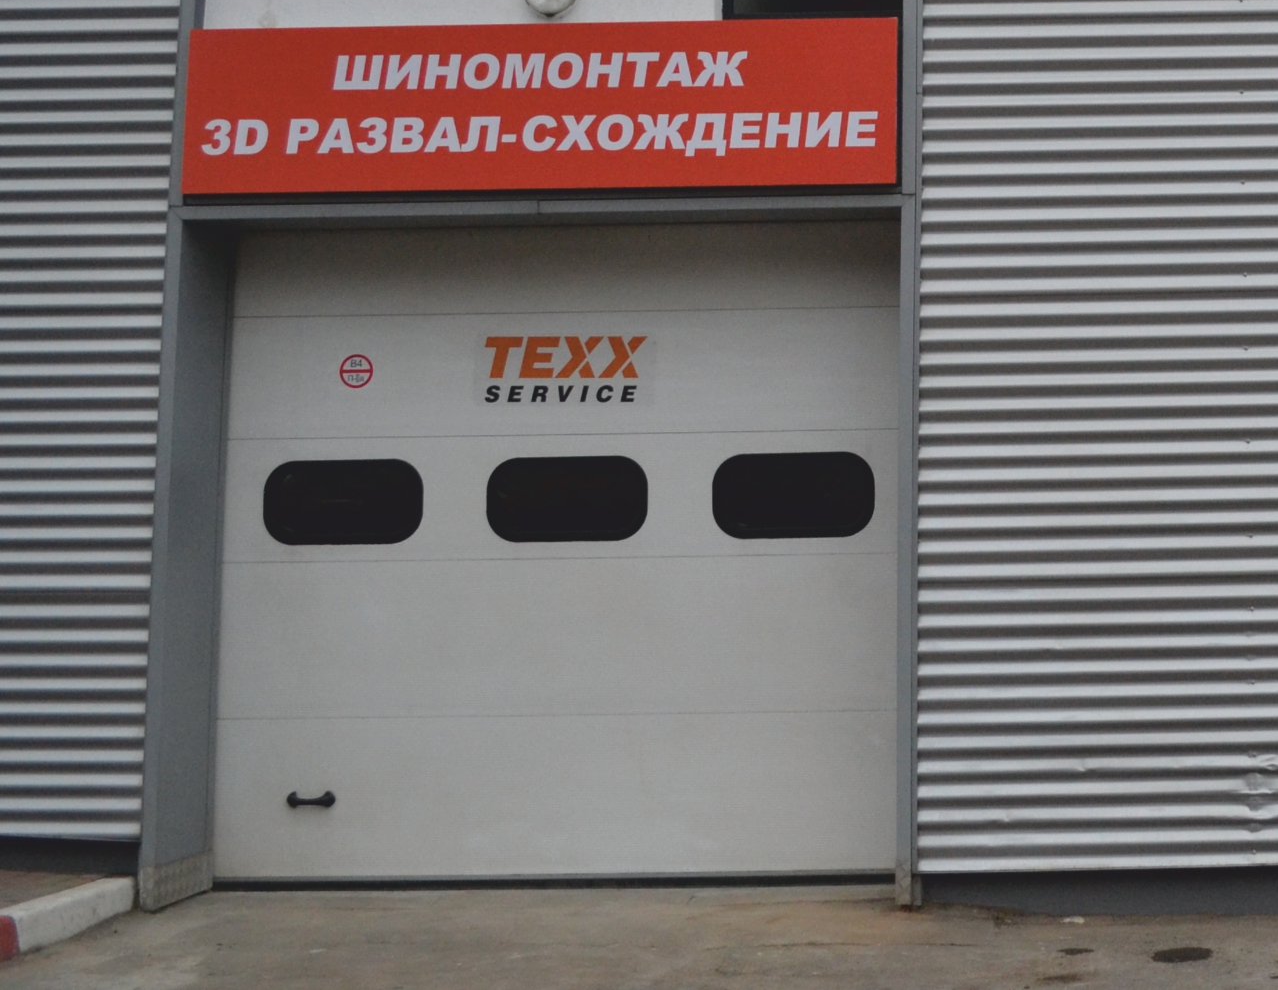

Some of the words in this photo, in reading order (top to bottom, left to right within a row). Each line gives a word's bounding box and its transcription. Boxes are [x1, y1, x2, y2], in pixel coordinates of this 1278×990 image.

[333, 50, 747, 91] ШИНОМОНТАЖ
[201, 119, 269, 156] 3D
[286, 111, 878, 157] РАЗВАЛ-СХОЖДЕНИЕ
[485, 336, 647, 378] TEXX
[485, 385, 637, 403] SERVICE
